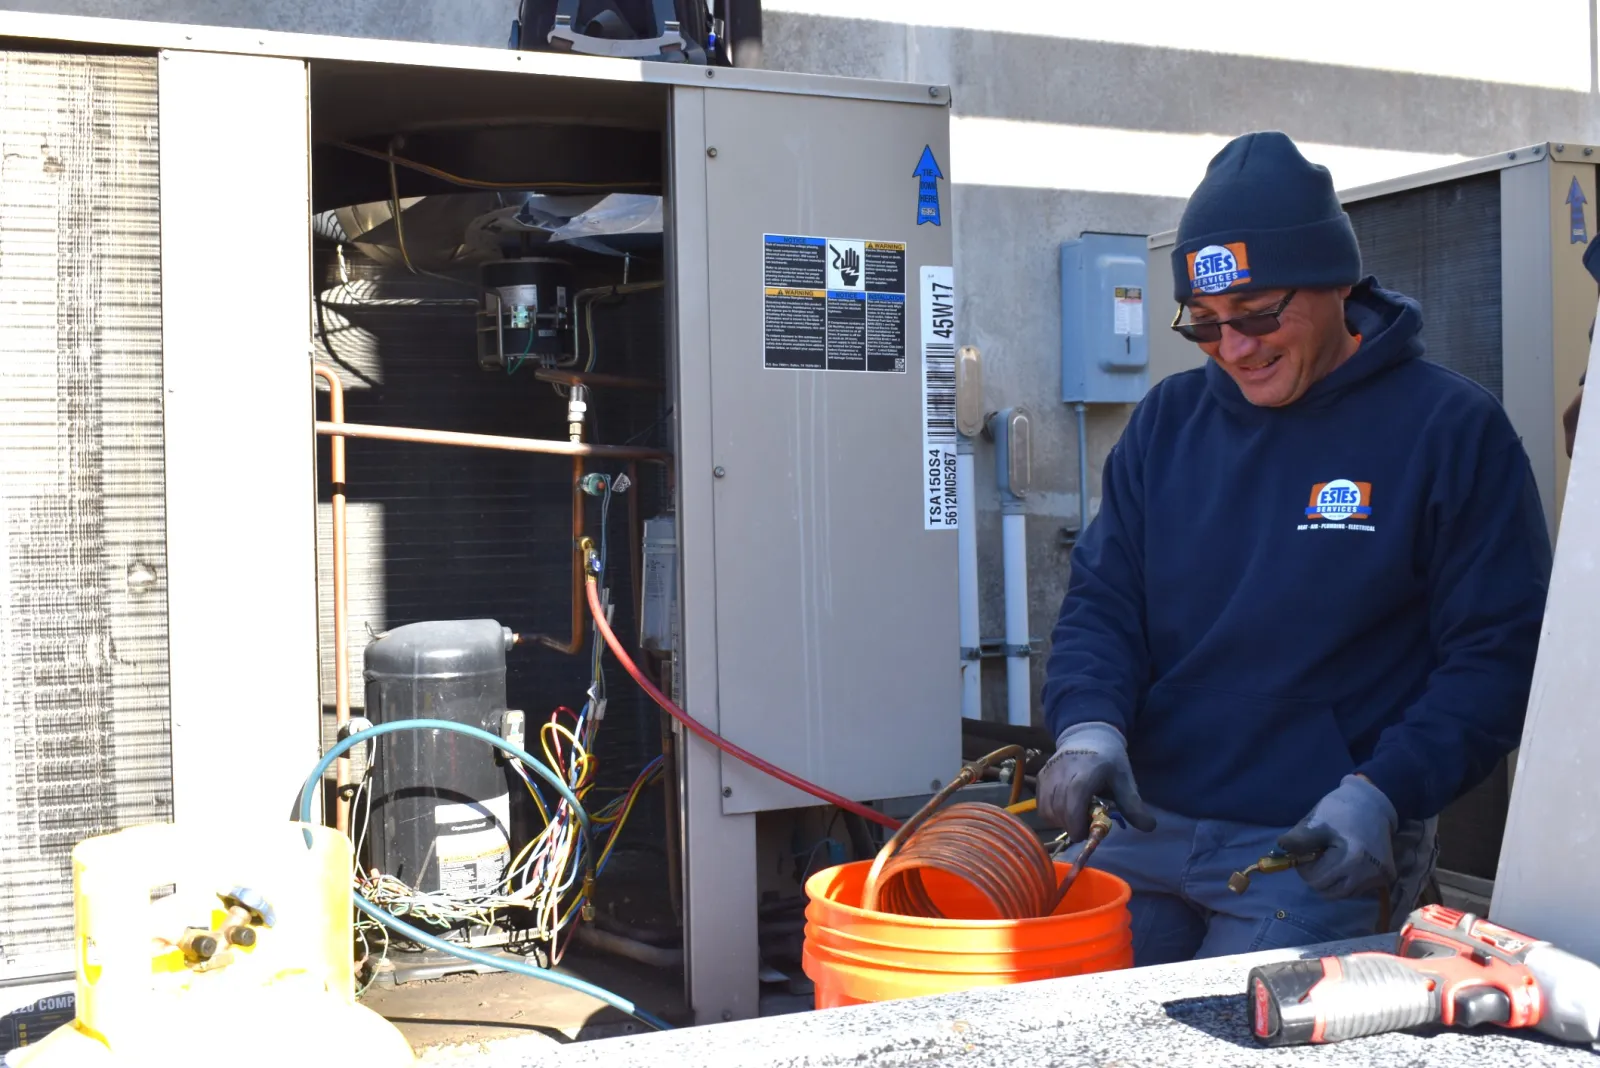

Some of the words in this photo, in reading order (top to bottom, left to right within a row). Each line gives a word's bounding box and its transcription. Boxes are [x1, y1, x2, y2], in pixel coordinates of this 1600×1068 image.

[922, 168, 934, 176] TIE
[920, 194, 937, 203] HERE
[783, 236, 806, 244] NOTICE
[873, 243, 903, 251] WARNING
[1195, 253, 1233, 276] ESTES
[1193, 271, 1238, 288] SERVICES
[932, 282, 954, 339] 45W17
[928, 449, 941, 525] TSA150S4
[944, 452, 957, 525] 5612M05267
[1320, 487, 1357, 503] ESTES
